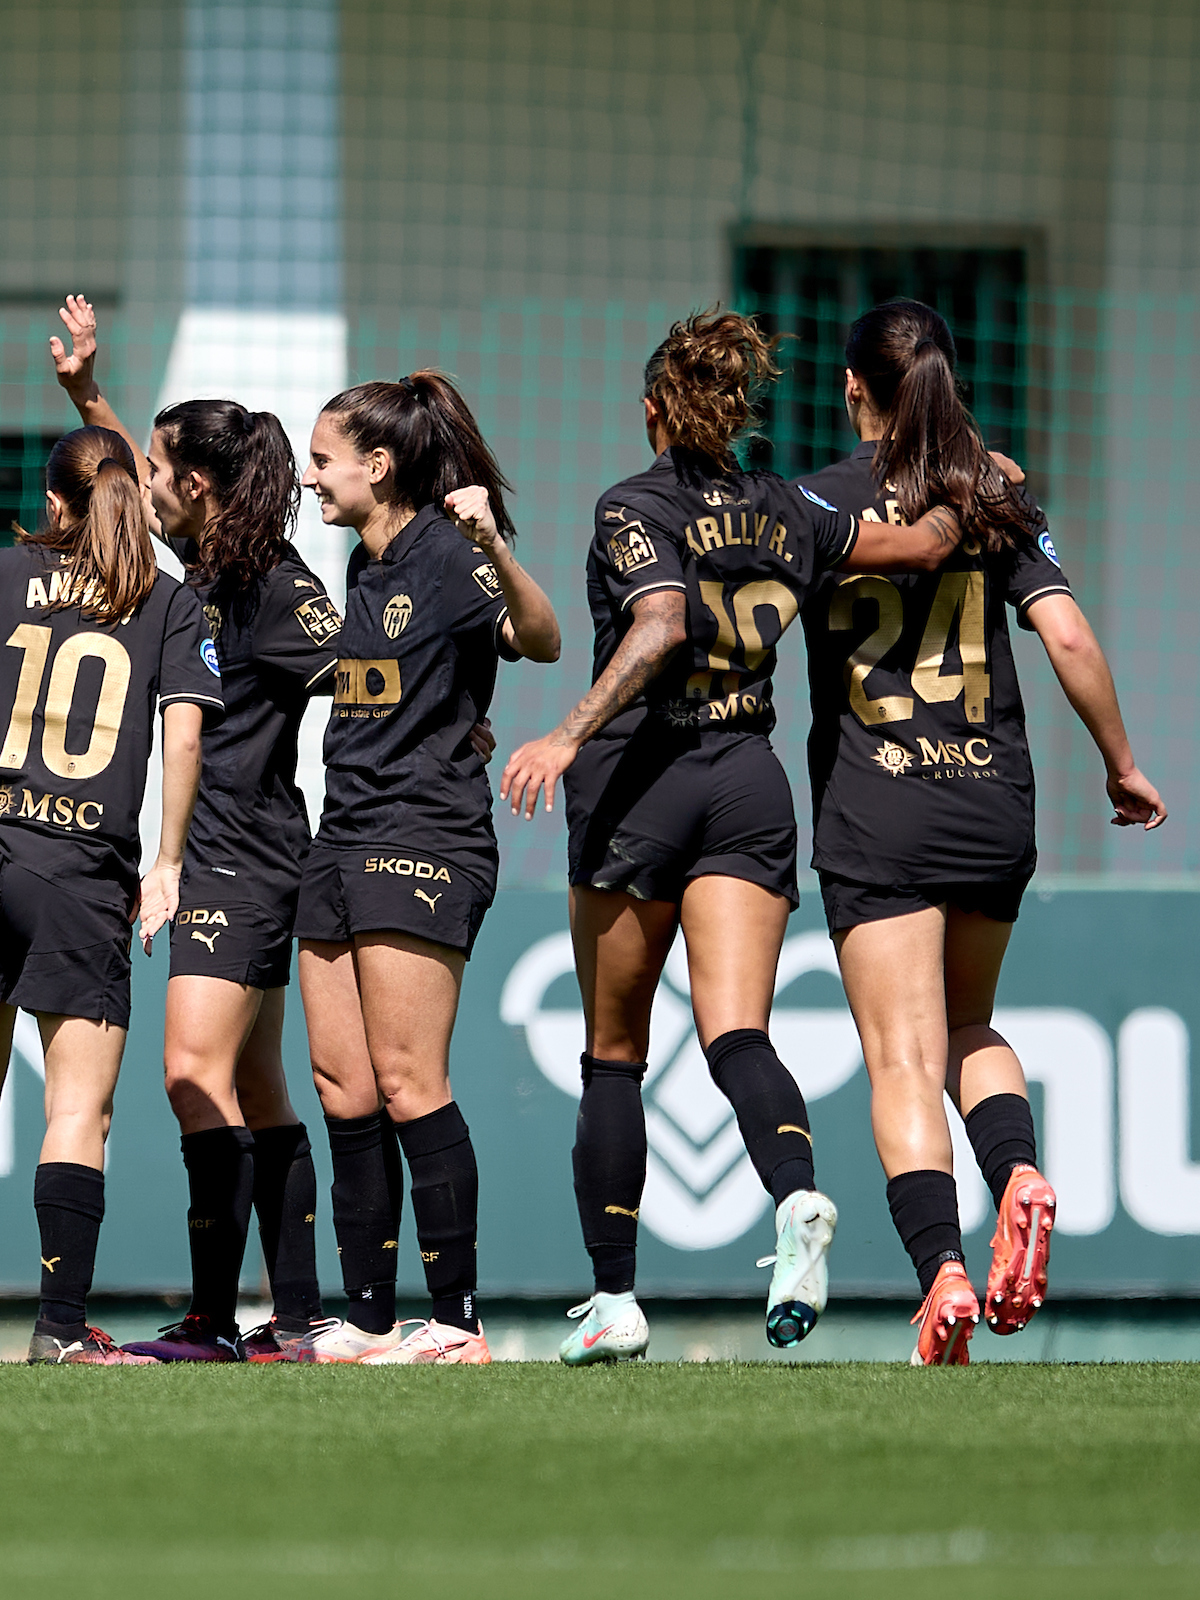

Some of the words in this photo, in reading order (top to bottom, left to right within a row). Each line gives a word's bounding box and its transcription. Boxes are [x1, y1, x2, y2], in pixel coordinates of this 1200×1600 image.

[615, 543, 649, 572] TEM
[828, 571, 990, 725] 24
[916, 737, 993, 768] MSC
[921, 769, 999, 780] CRUCROS
[17, 788, 104, 831] MSC
[176, 909, 229, 927] ODA
[420, 1251, 440, 1263] CF
